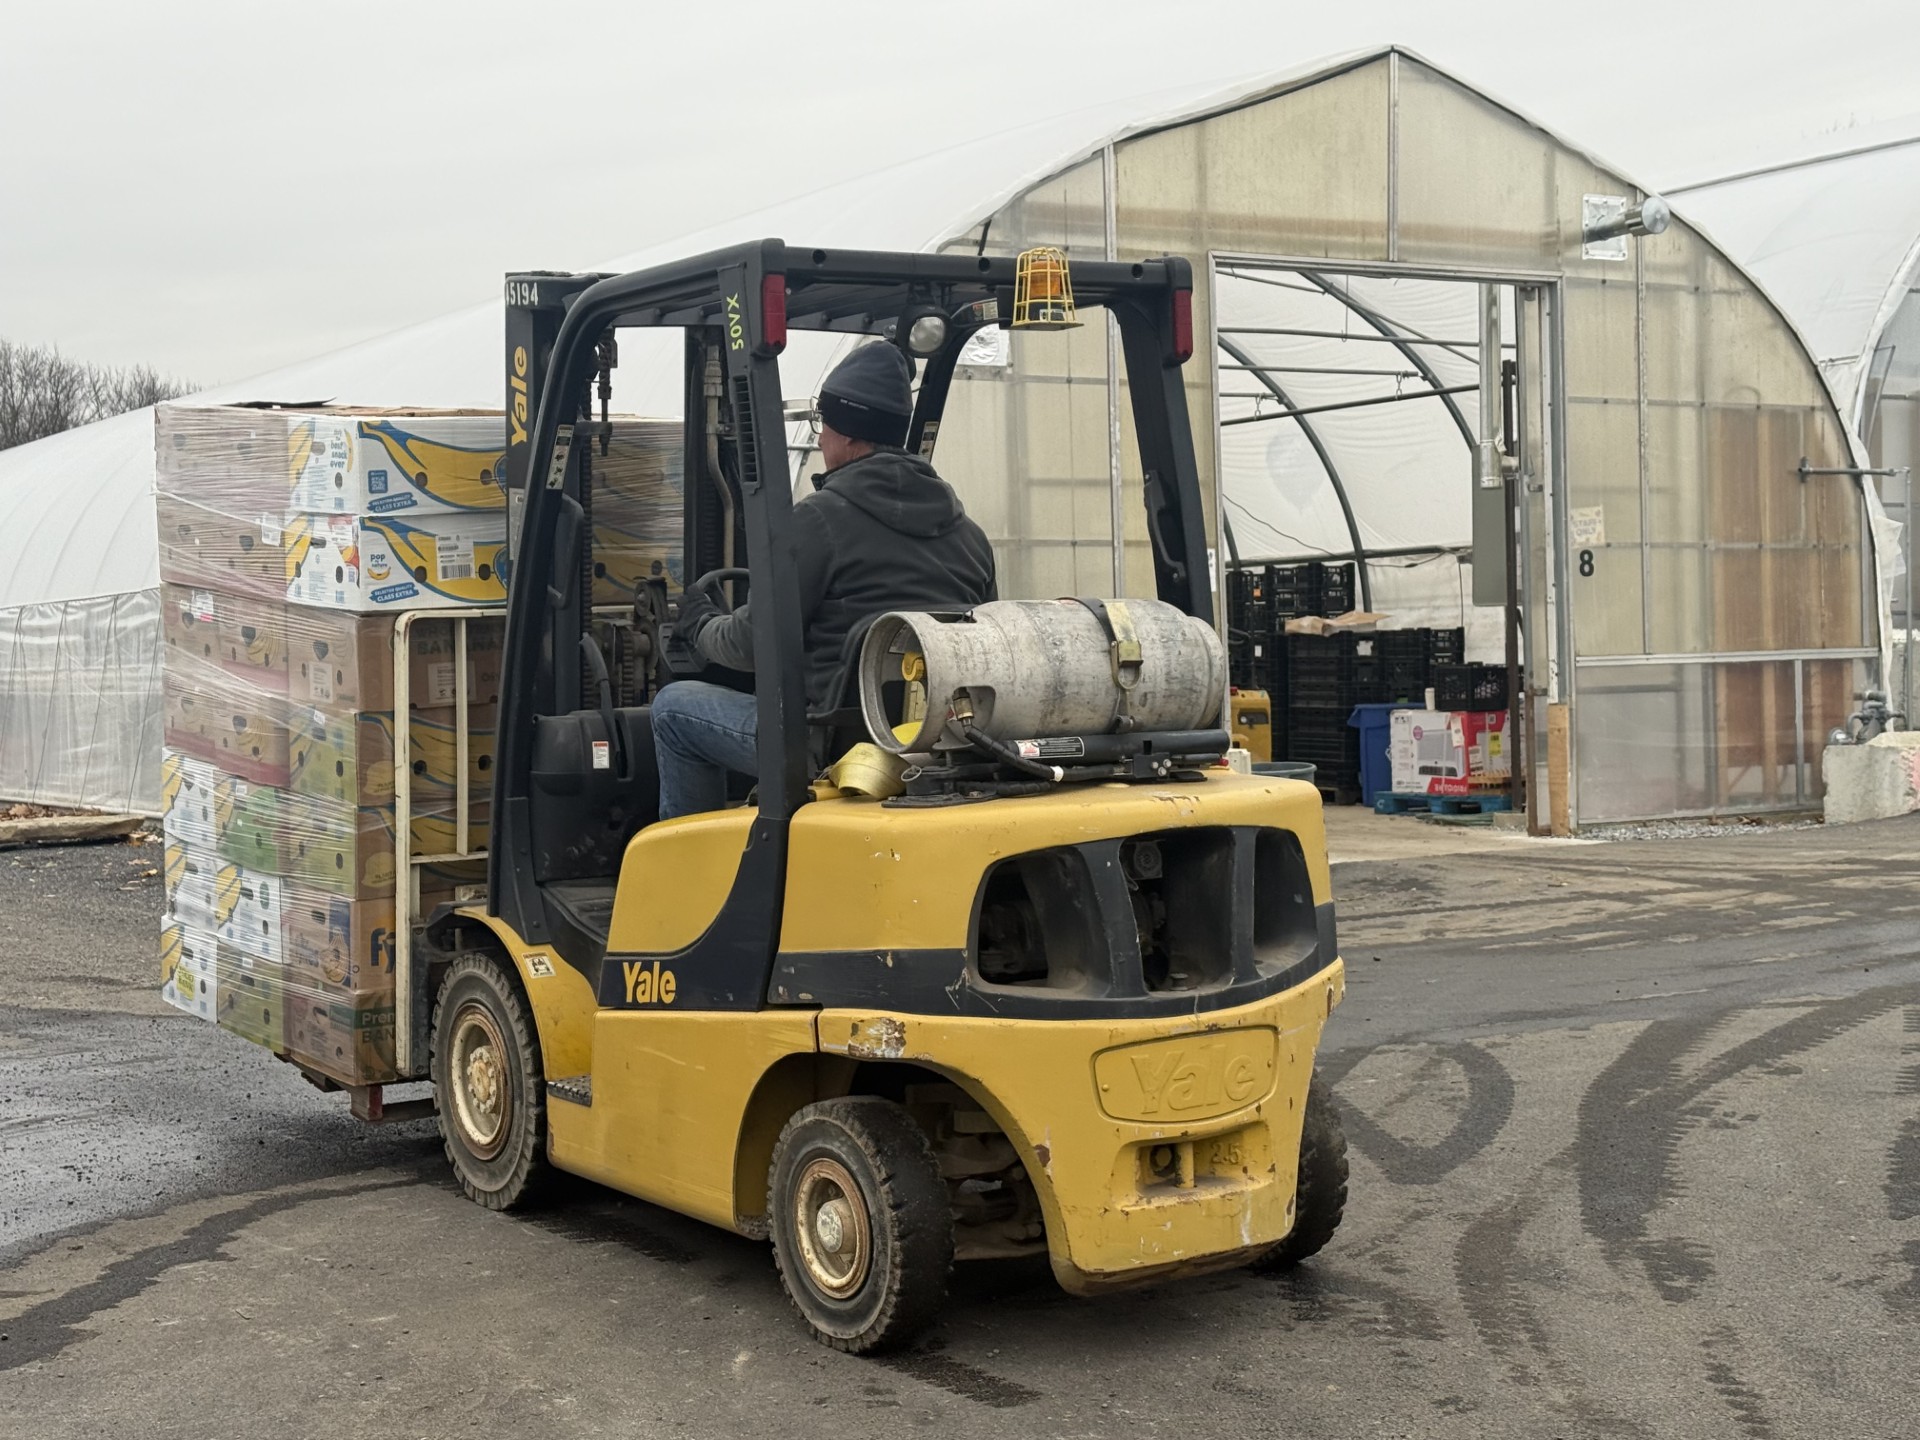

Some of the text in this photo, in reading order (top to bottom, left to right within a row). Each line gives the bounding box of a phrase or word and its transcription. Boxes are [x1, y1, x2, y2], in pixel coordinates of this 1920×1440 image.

[726, 293, 744, 350] 50VX
[511, 346, 527, 446] Yale
[330, 460, 345, 468] ever
[375, 499, 412, 512] CLASS EXTRA
[1576, 527, 1596, 537] ONLY
[370, 553, 386, 562] pop
[1579, 549, 1594, 577] 8
[377, 589, 414, 602] CLASS EXTRA
[623, 961, 676, 1004] Yale
[1131, 1043, 1255, 1115] Yale
